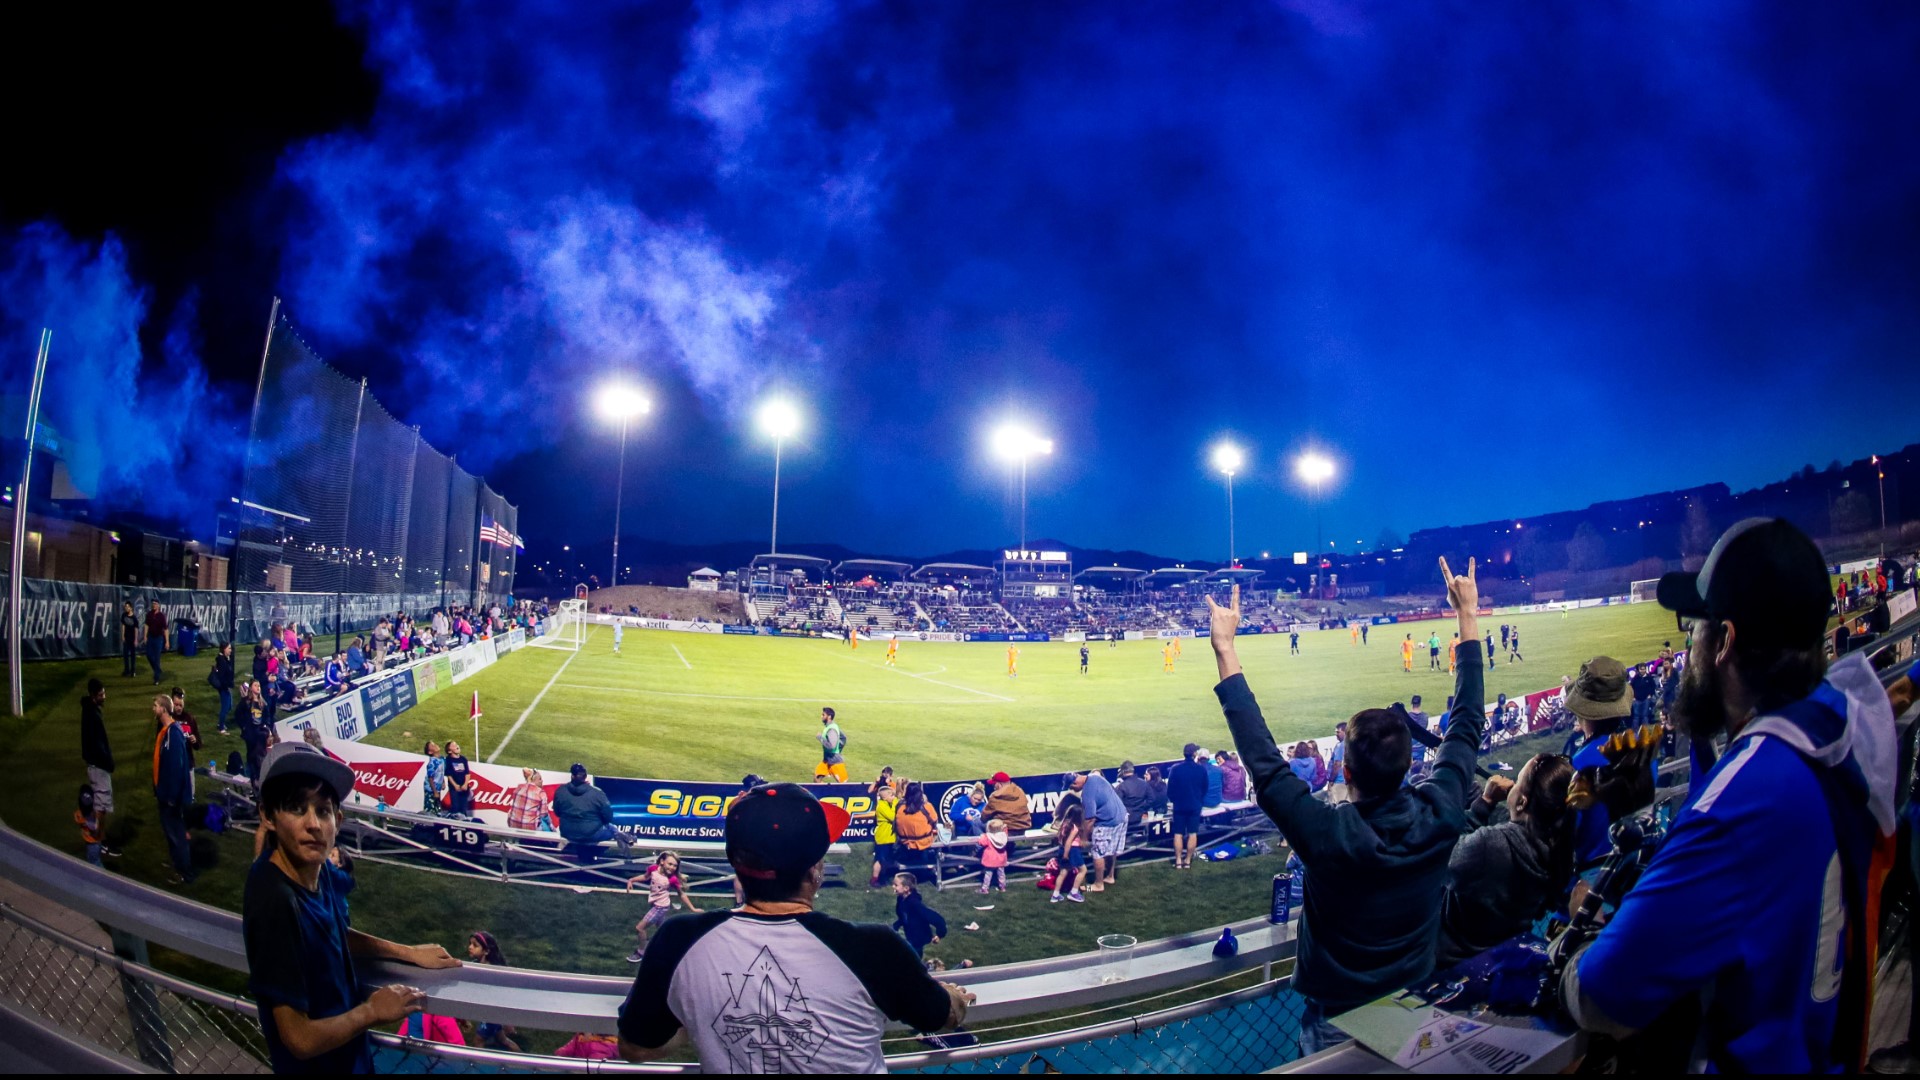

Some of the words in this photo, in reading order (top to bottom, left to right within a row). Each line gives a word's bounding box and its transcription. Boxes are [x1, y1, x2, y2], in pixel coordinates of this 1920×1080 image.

[91, 602, 112, 638] FC
[335, 702, 352, 723] BUD
[336, 717, 359, 740] LIGHT
[354, 768, 411, 790] weiser
[439, 827, 479, 845] 119
[634, 824, 656, 835] FULL
[659, 825, 697, 837] SERVICE
[699, 826, 724, 837] SIGN
